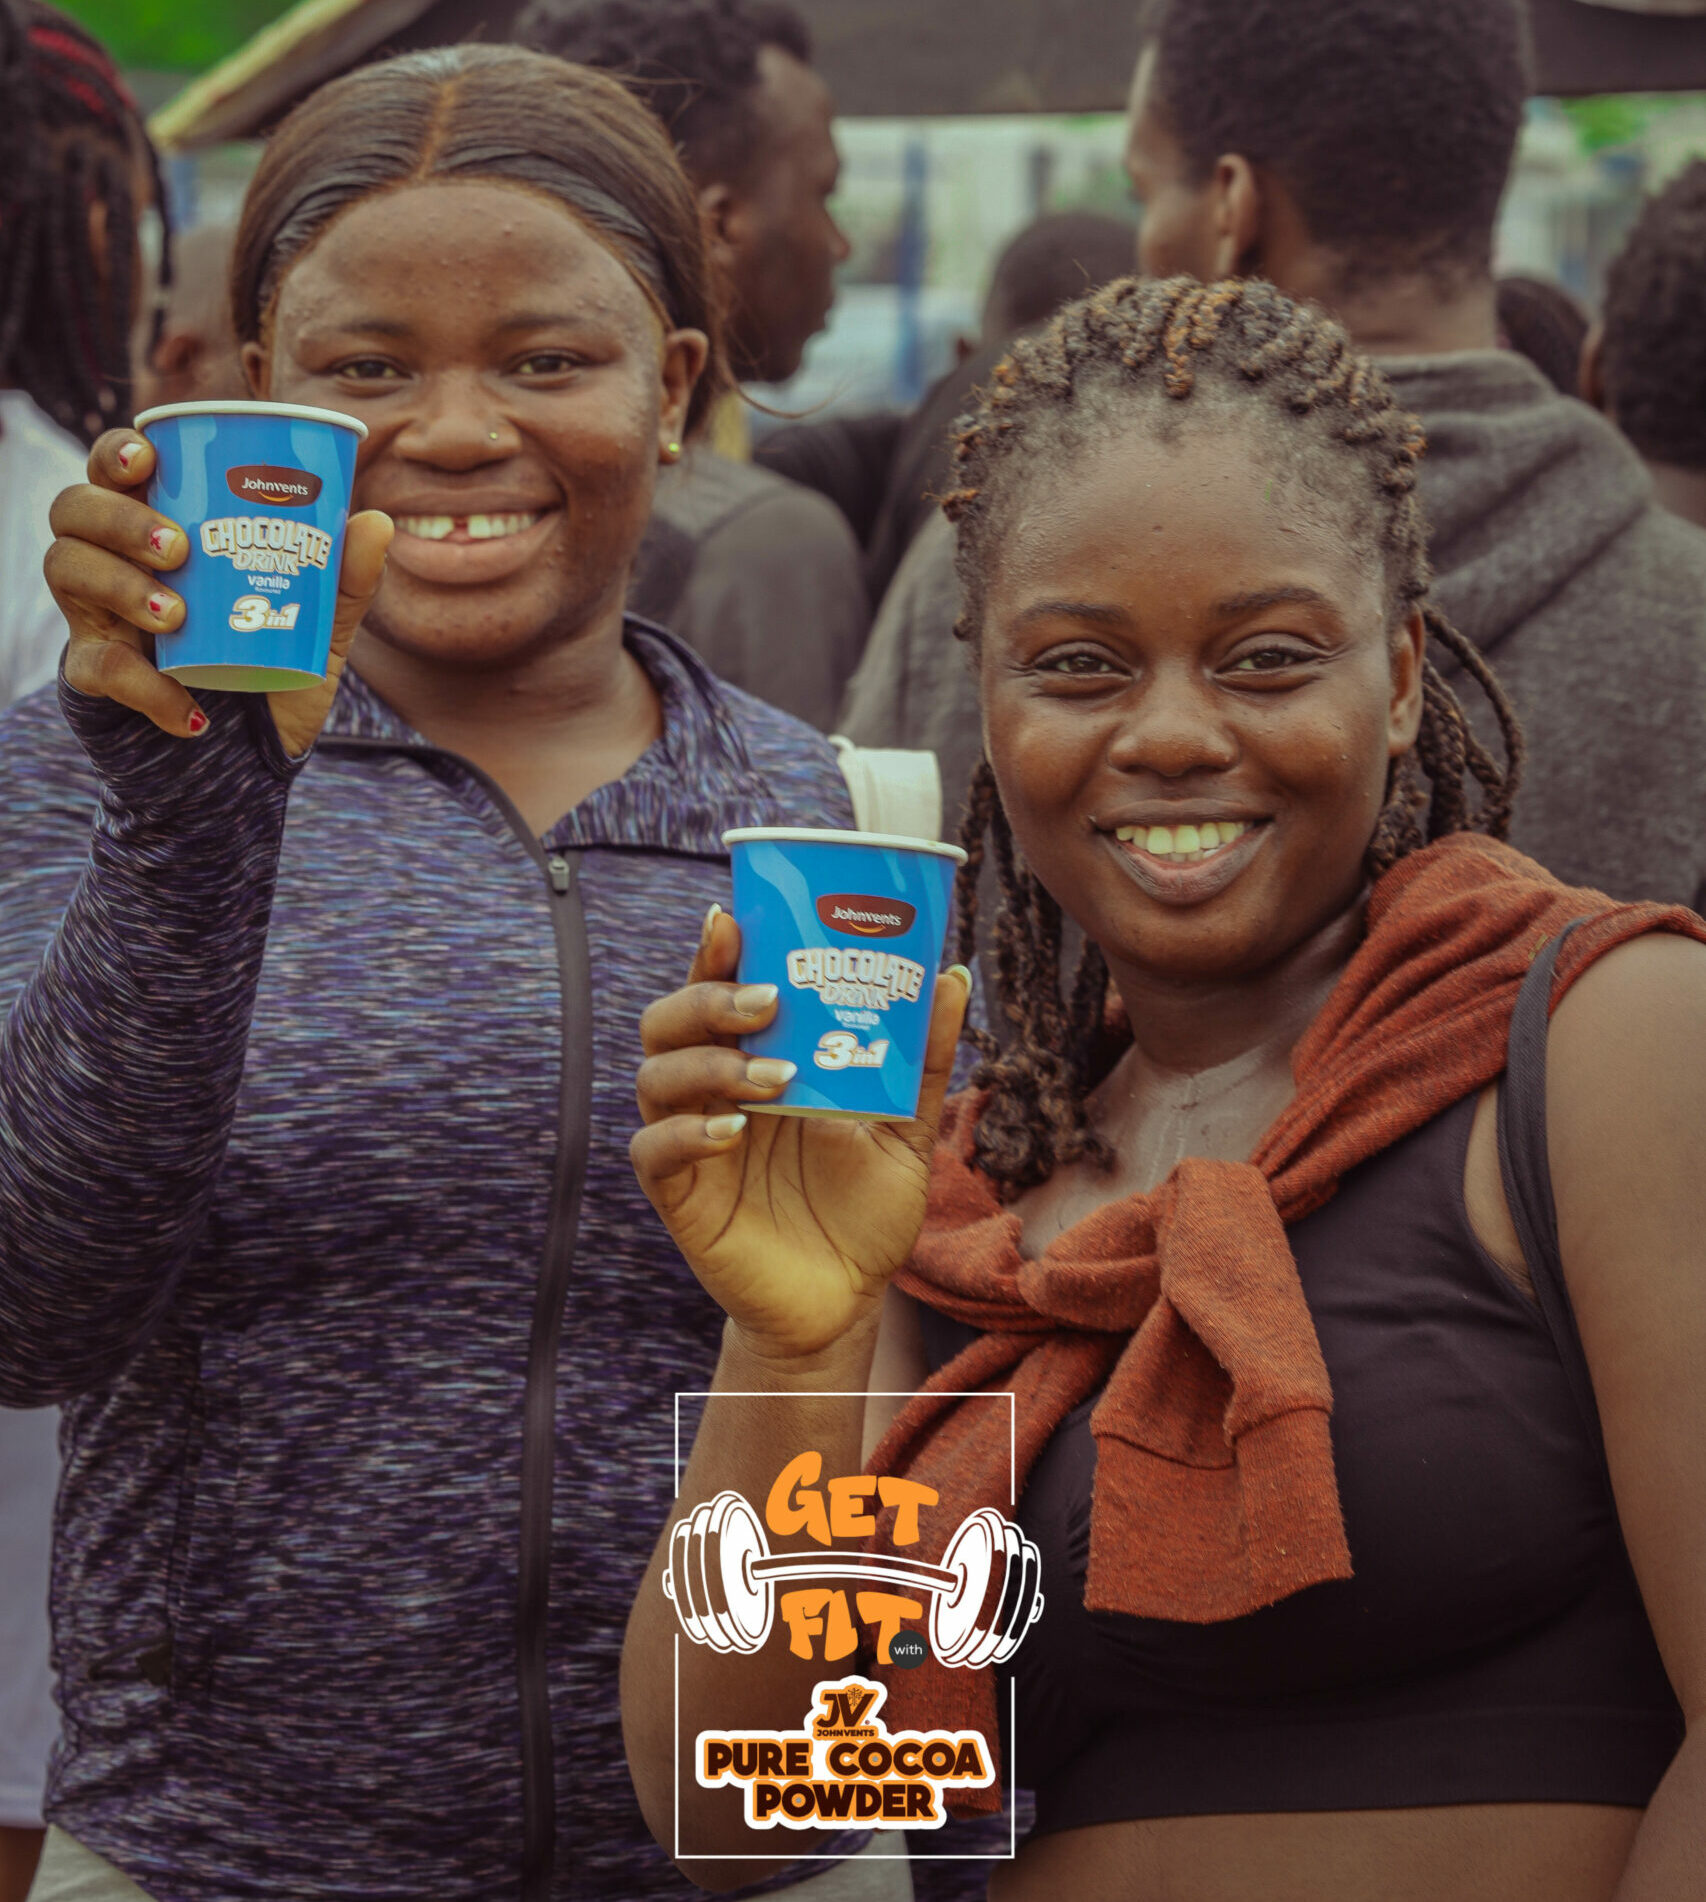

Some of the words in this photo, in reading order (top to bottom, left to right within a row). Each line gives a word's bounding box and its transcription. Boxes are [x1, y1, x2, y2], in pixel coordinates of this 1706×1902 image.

[241, 477, 309, 496] Johnvents
[201, 517, 332, 569] CHOCOLATE
[247, 574, 290, 590] vanilla
[229, 595, 300, 631] 3in1
[831, 905, 902, 926] Johnvents
[787, 948, 925, 1002] CHOCOLATE
[834, 1009, 880, 1026] vanilla
